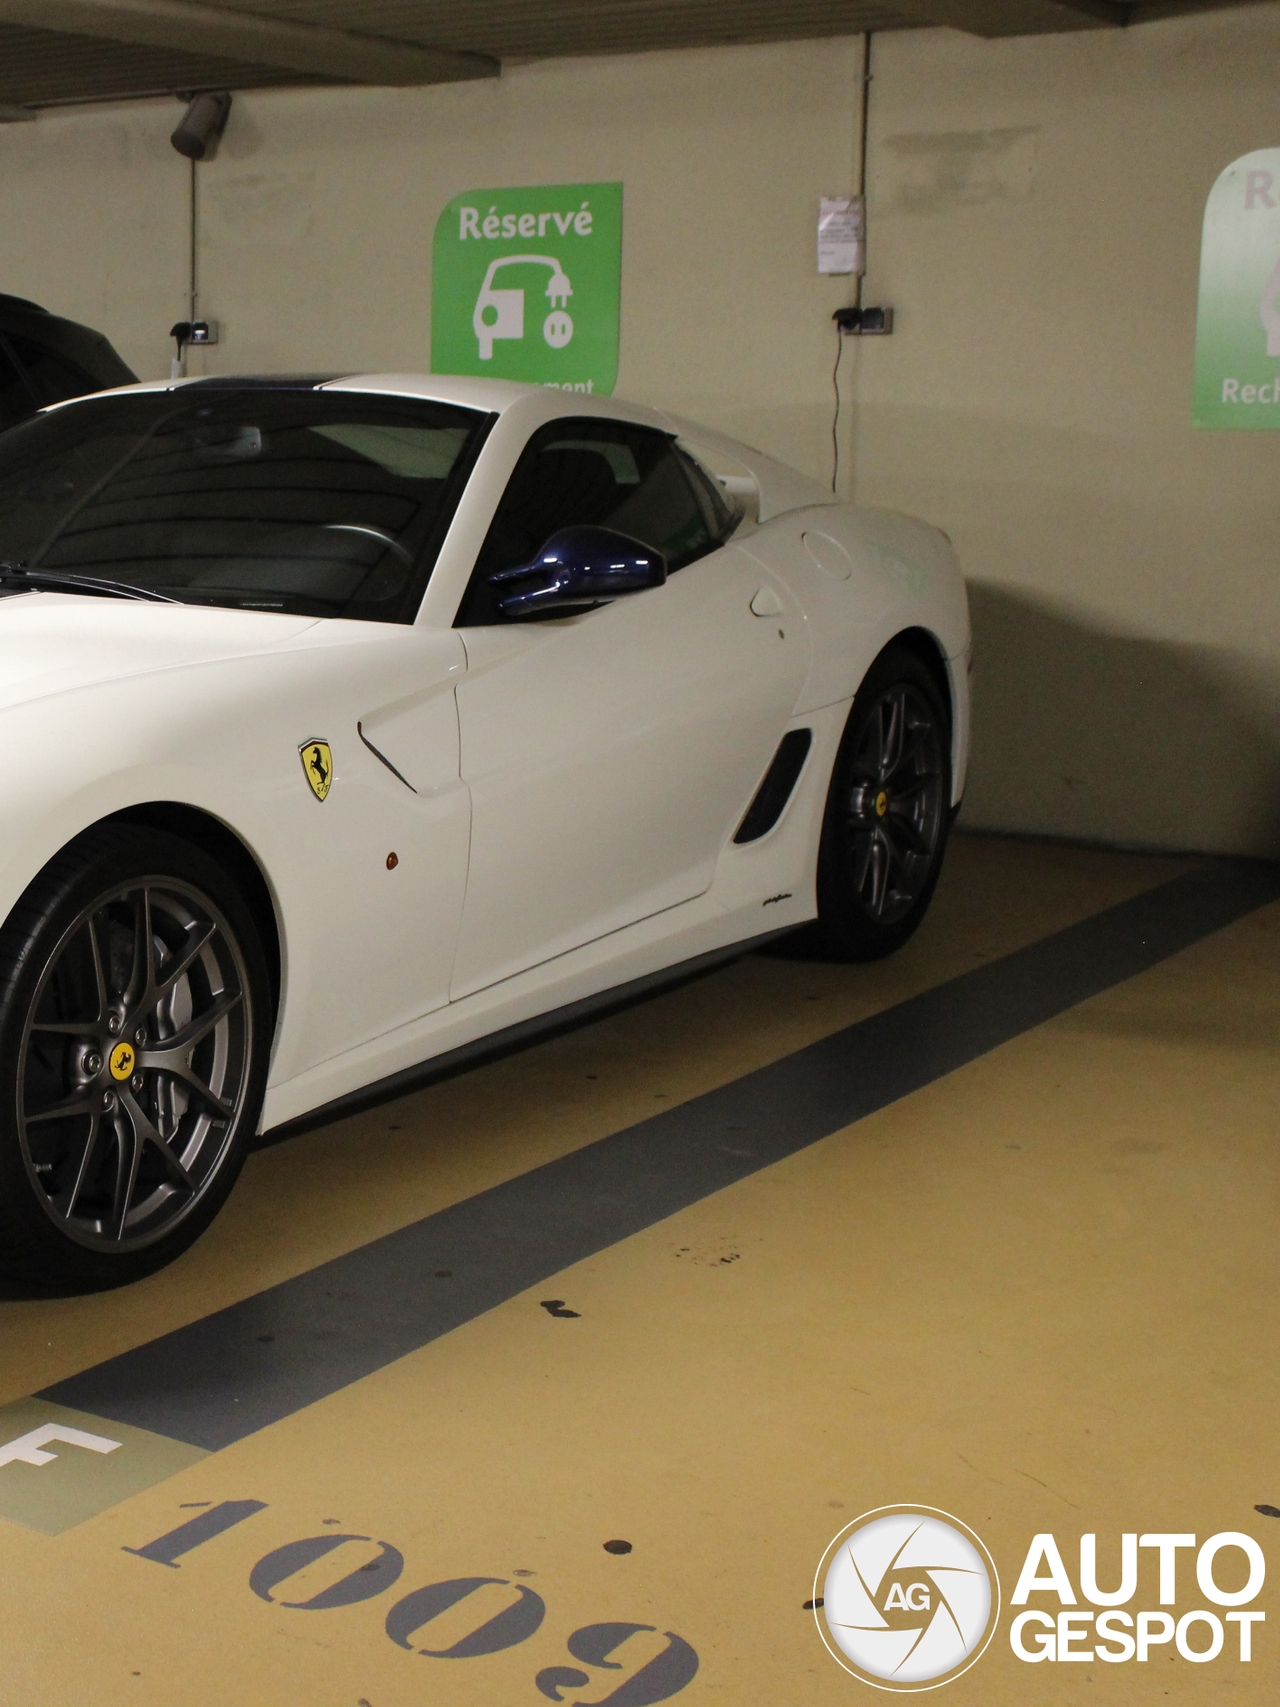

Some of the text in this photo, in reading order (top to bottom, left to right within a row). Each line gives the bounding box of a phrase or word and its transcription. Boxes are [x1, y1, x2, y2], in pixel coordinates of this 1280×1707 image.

[1244, 171, 1280, 210] R
[459, 202, 593, 240] Réservé
[120, 1498, 700, 1707] 1009
